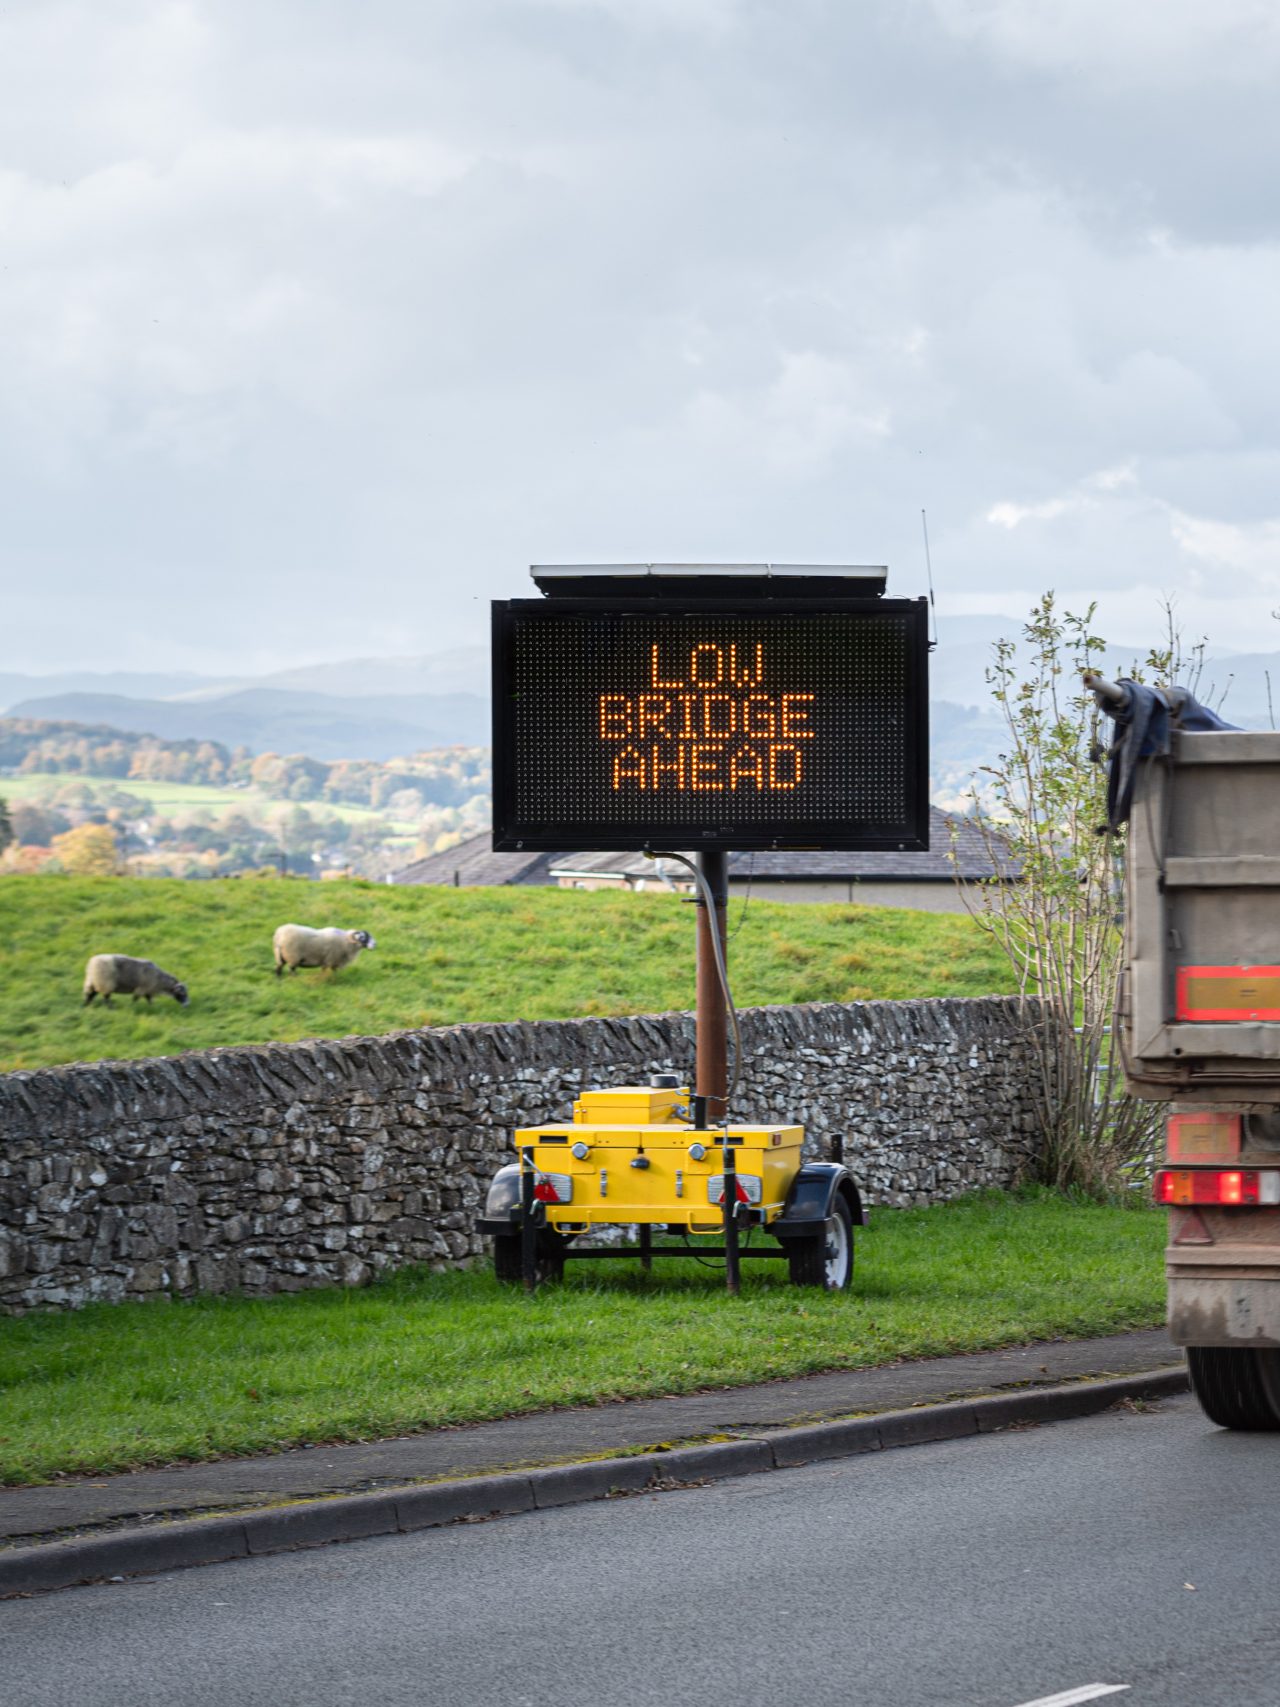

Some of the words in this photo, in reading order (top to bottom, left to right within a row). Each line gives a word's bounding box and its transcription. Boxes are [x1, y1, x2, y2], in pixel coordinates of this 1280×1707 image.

[651, 643, 763, 689] LOW
[600, 693, 816, 740] BRIDGE
[613, 744, 803, 791] AHEAD
